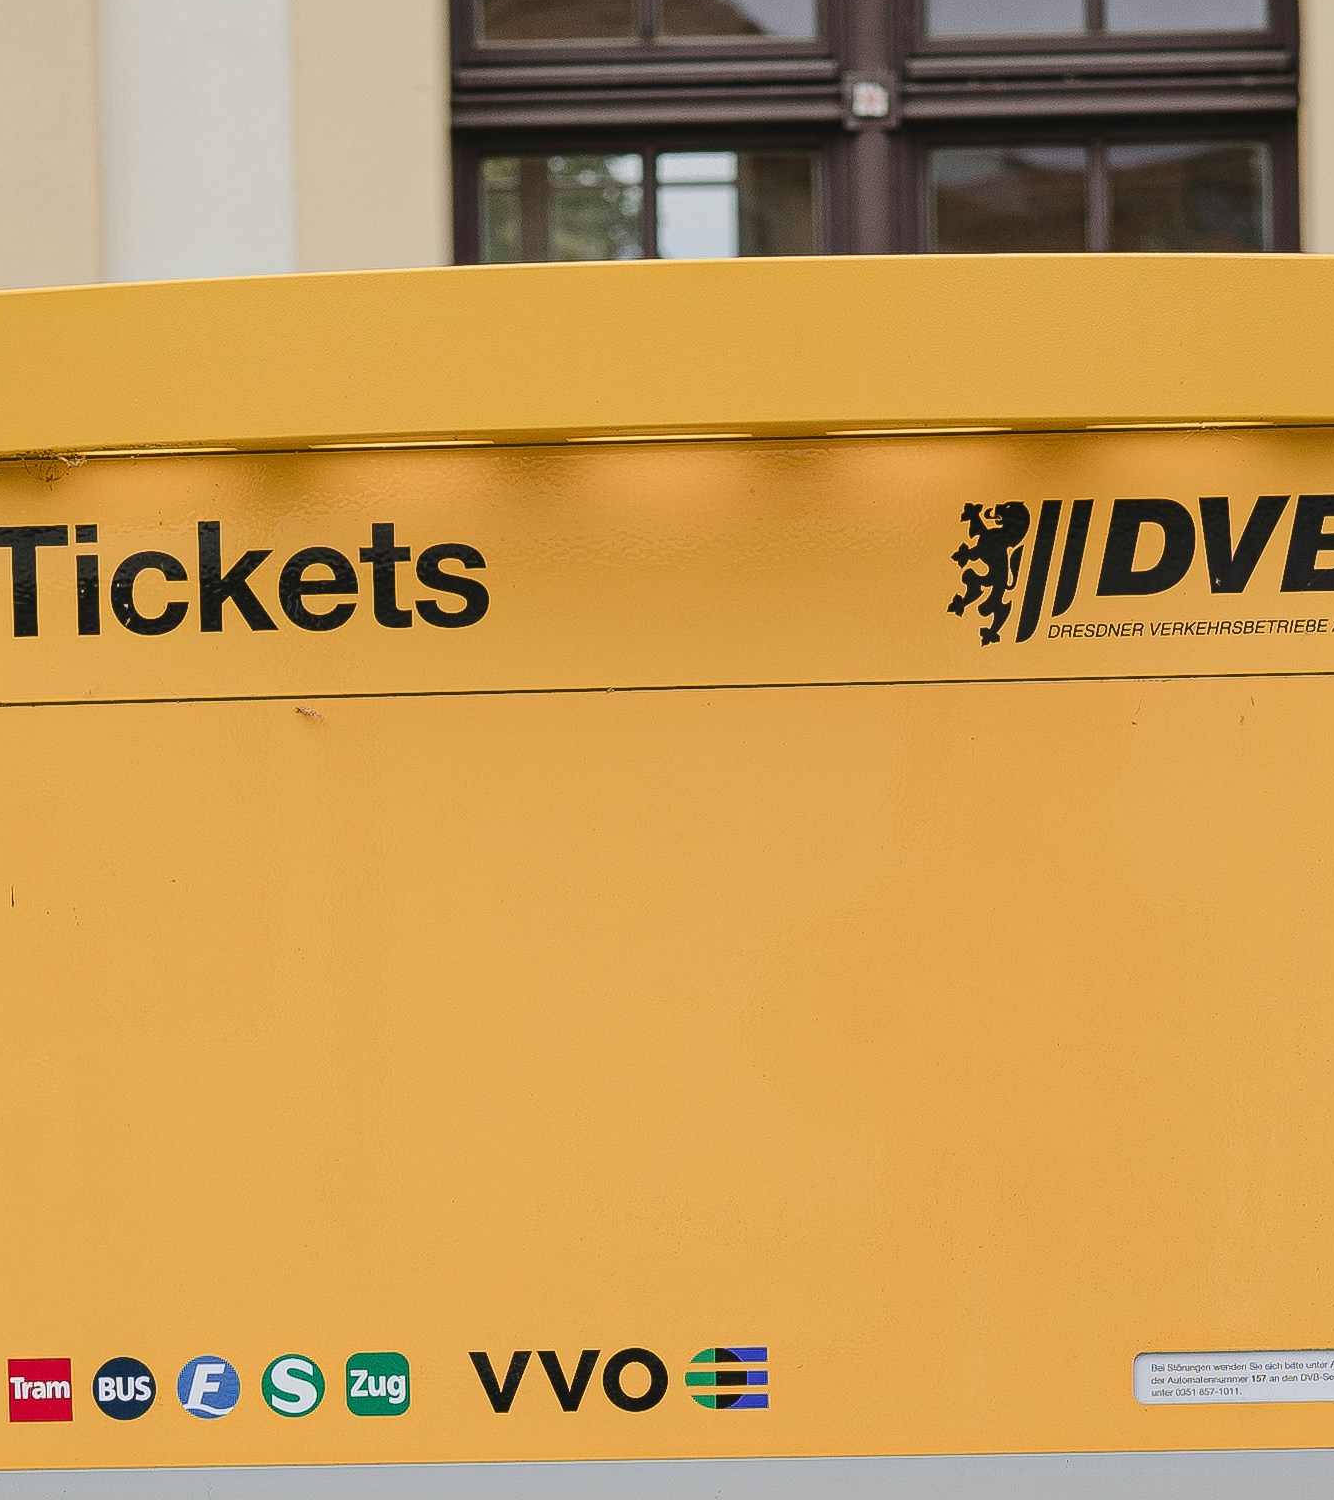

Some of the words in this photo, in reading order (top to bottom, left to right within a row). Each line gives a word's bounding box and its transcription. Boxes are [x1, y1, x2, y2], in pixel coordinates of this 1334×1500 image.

[1047, 620, 1145, 640] DRESDNER
[1149, 618, 1328, 638] VERKEHRSBETRIEBE
[9, 1376, 71, 1400] Tram
[98, 1376, 152, 1402] BUS
[271, 1358, 318, 1414] S
[350, 1369, 408, 1404] Zug
[467, 1347, 669, 1414] VVO
[1252, 1374, 1266, 1382] 157
